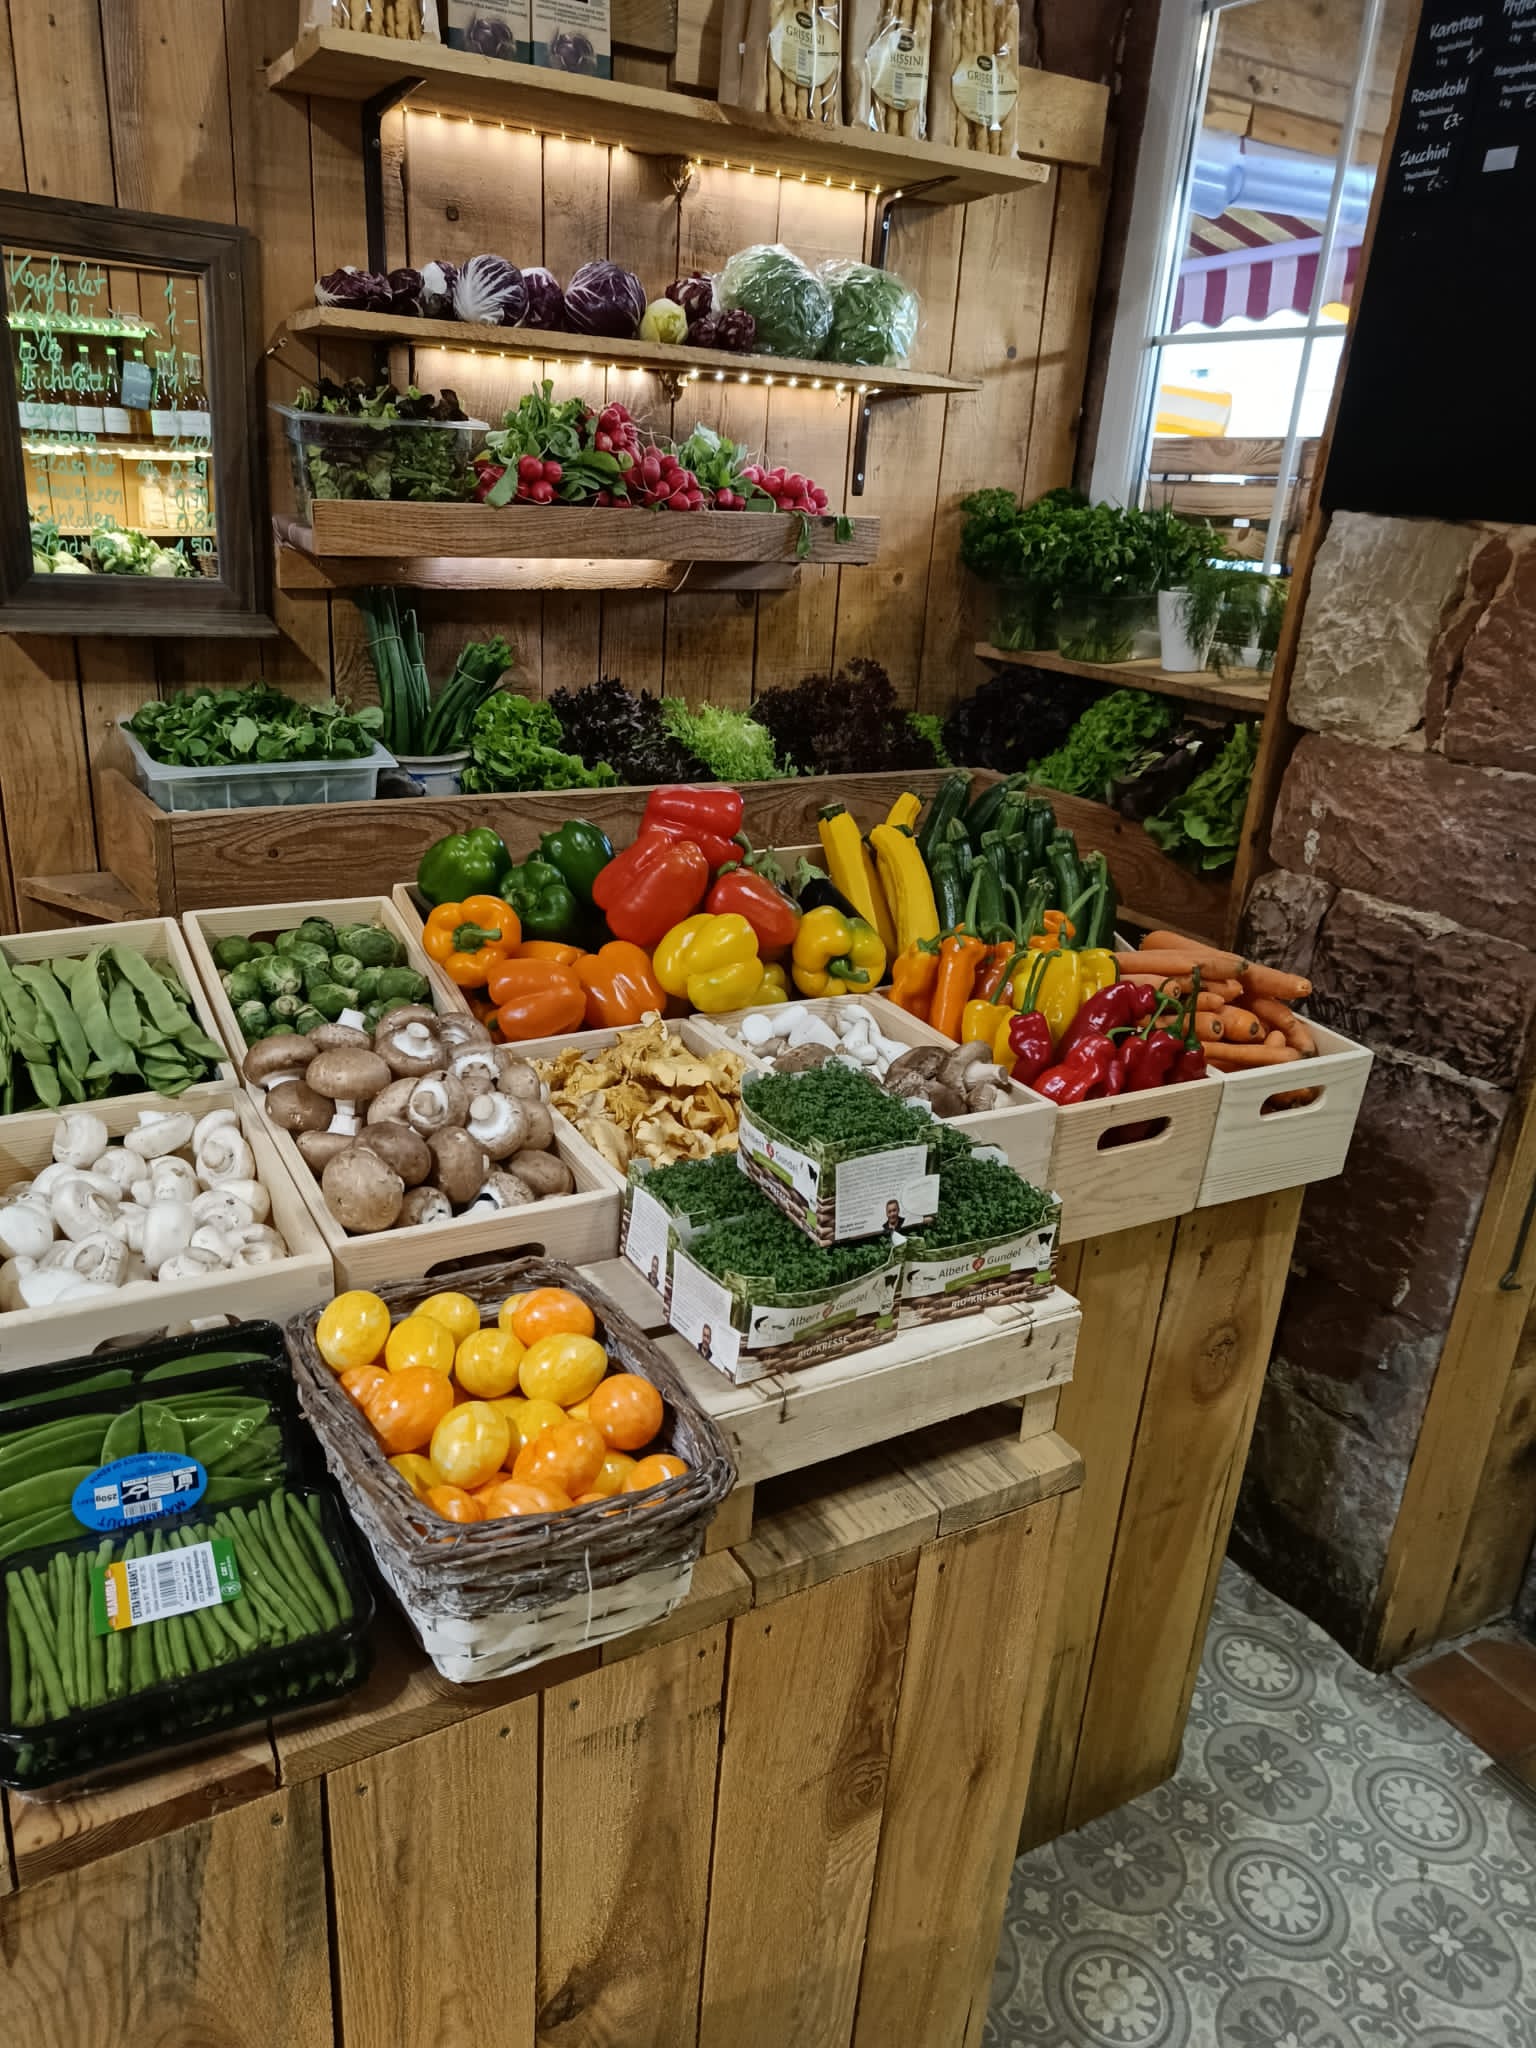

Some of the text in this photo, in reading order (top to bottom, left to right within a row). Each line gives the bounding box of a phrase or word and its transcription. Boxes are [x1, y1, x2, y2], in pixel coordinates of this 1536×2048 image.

[1429, 16, 1483, 40] Karotten
[885, 53, 924, 67] RISSINI
[1410, 77, 1470, 104] Rosenkohl
[1400, 142, 1451, 167] Zucchini
[10, 250, 107, 302] Kopfsalat
[26, 361, 104, 391] Eichblatt
[31, 449, 117, 478] Feldsalat
[938, 1264, 970, 1279] Albert
[986, 1248, 1022, 1265] Gundel
[787, 1312, 821, 1329] Albert
[835, 1293, 868, 1311] Gundel
[96, 1499, 187, 1529] MANGETOUT
[128, 1570, 139, 1588] BEANS
[132, 1601, 142, 1619] EXTRA
